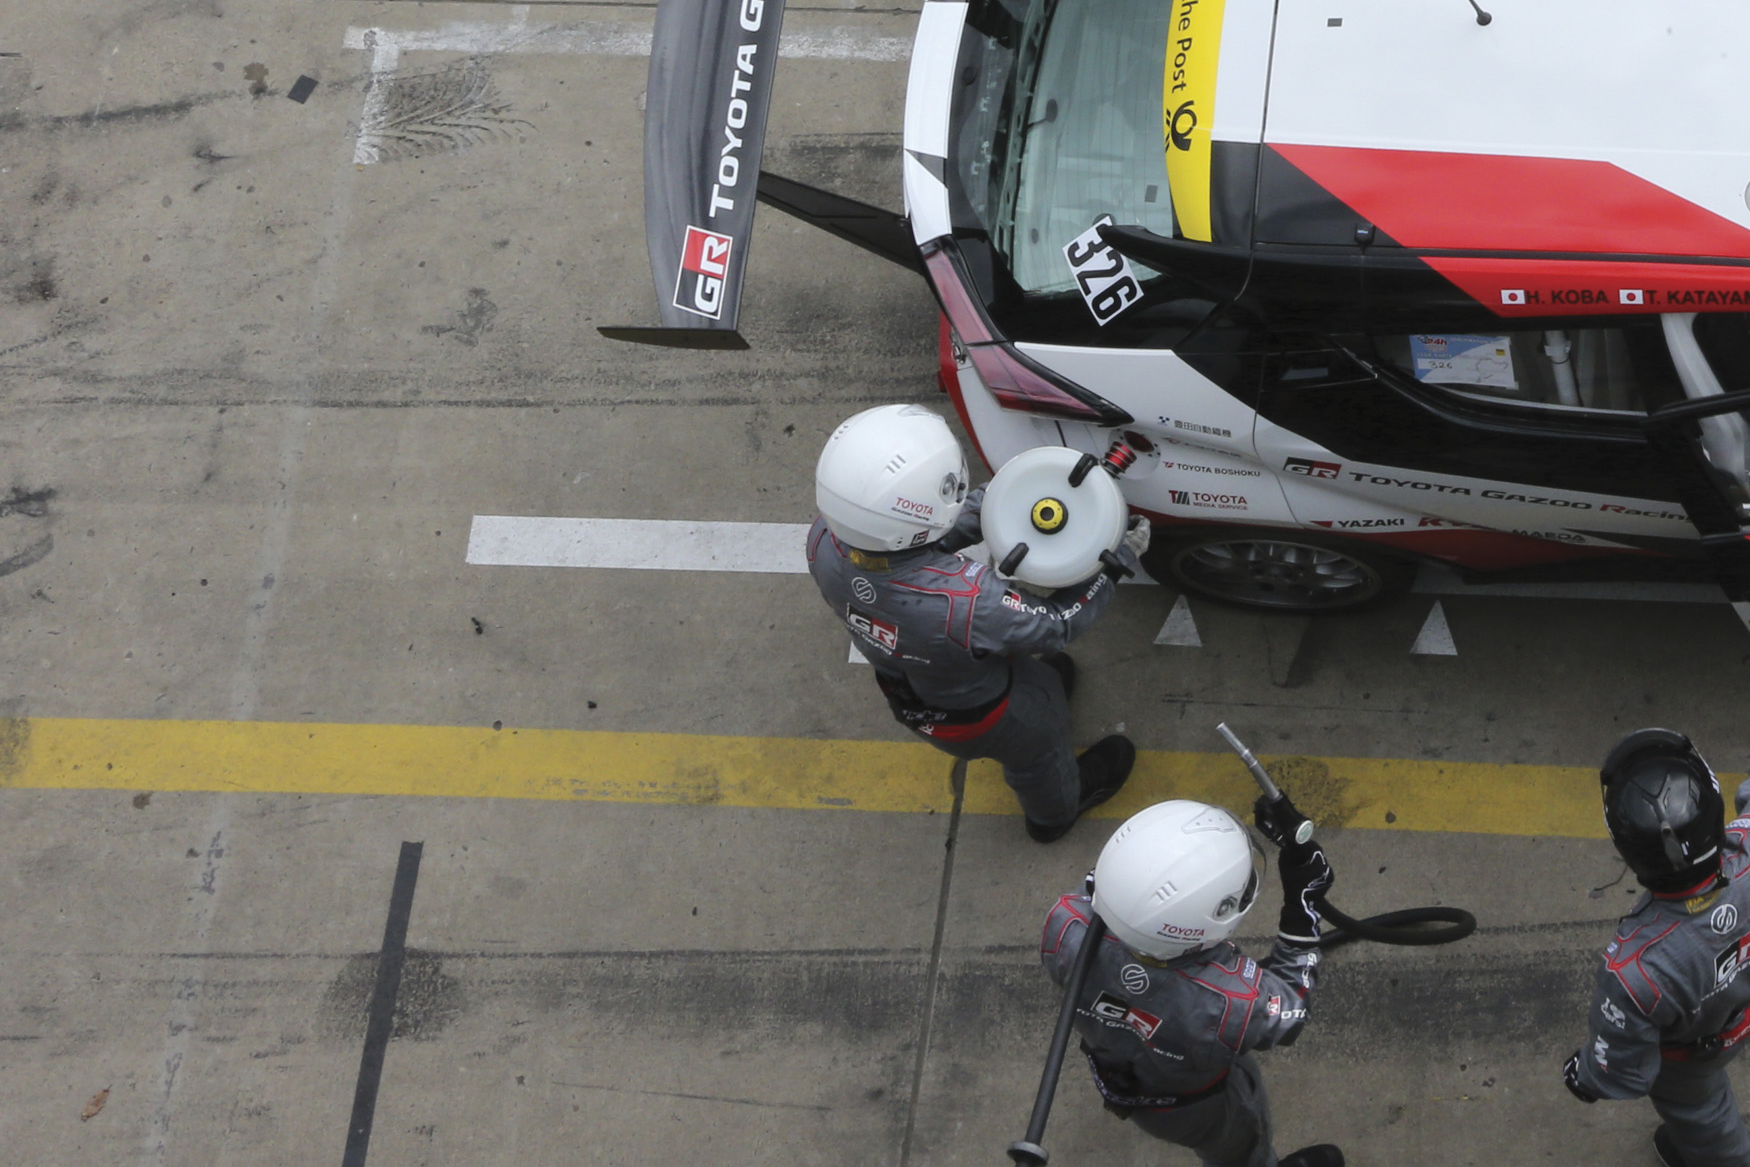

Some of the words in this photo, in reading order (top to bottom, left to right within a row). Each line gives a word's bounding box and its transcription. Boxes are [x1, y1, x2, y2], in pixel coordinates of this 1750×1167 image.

[1171, 37, 1193, 94] Post
[710, 45, 758, 217] TOYOTA
[694, 233, 733, 316] GR
[1066, 226, 1138, 323] 326
[1525, 290, 1546, 305] H.
[1550, 289, 1610, 305] KOBA
[1645, 290, 1663, 305] T.
[1177, 463, 1212, 474] TOYOTA
[1214, 468, 1261, 477] BOSHOKU
[1284, 459, 1341, 480] GR
[1348, 471, 1472, 497] TOYOTA
[1480, 489, 1593, 510] GAZOO
[896, 496, 934, 516] TOYOTA
[1192, 492, 1248, 505] TOYOTA
[1337, 517, 1405, 528] YAZAKI
[1002, 595, 1020, 611] GR
[849, 612, 897, 649] GR
[1161, 922, 1205, 937] TOYOTA
[1095, 1001, 1153, 1035] GR
